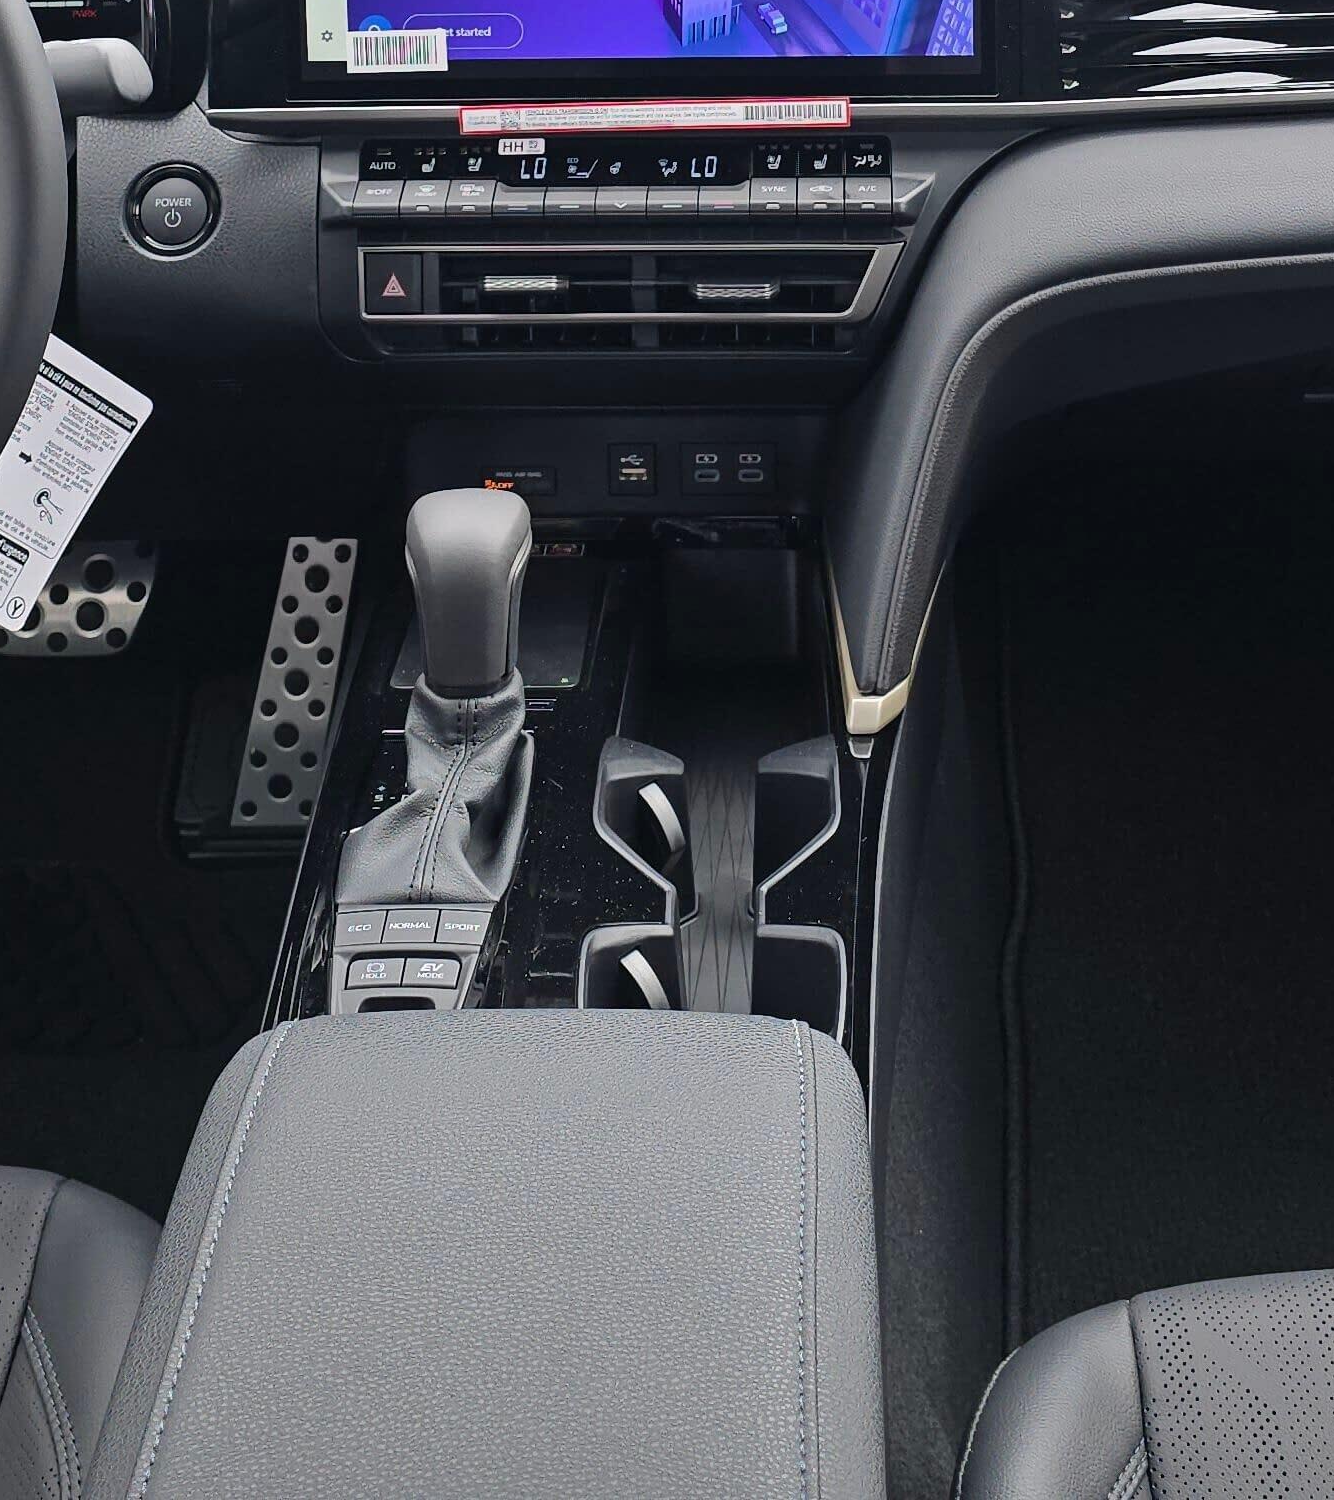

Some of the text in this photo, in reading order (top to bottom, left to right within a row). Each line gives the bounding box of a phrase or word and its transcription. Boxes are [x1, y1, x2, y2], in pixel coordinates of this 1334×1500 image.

[455, 26, 491, 37] started
[502, 141, 524, 153] HH
[369, 162, 396, 171] AUTO
[761, 185, 788, 193] SYNC
[155, 197, 192, 208] POWER
[347, 923, 372, 933] ECO
[388, 920, 432, 931] NORMAL
[443, 922, 481, 933] SPORT
[420, 962, 444, 973] EV
[360, 971, 387, 981] HOLD
[416, 972, 444, 981] MODE
